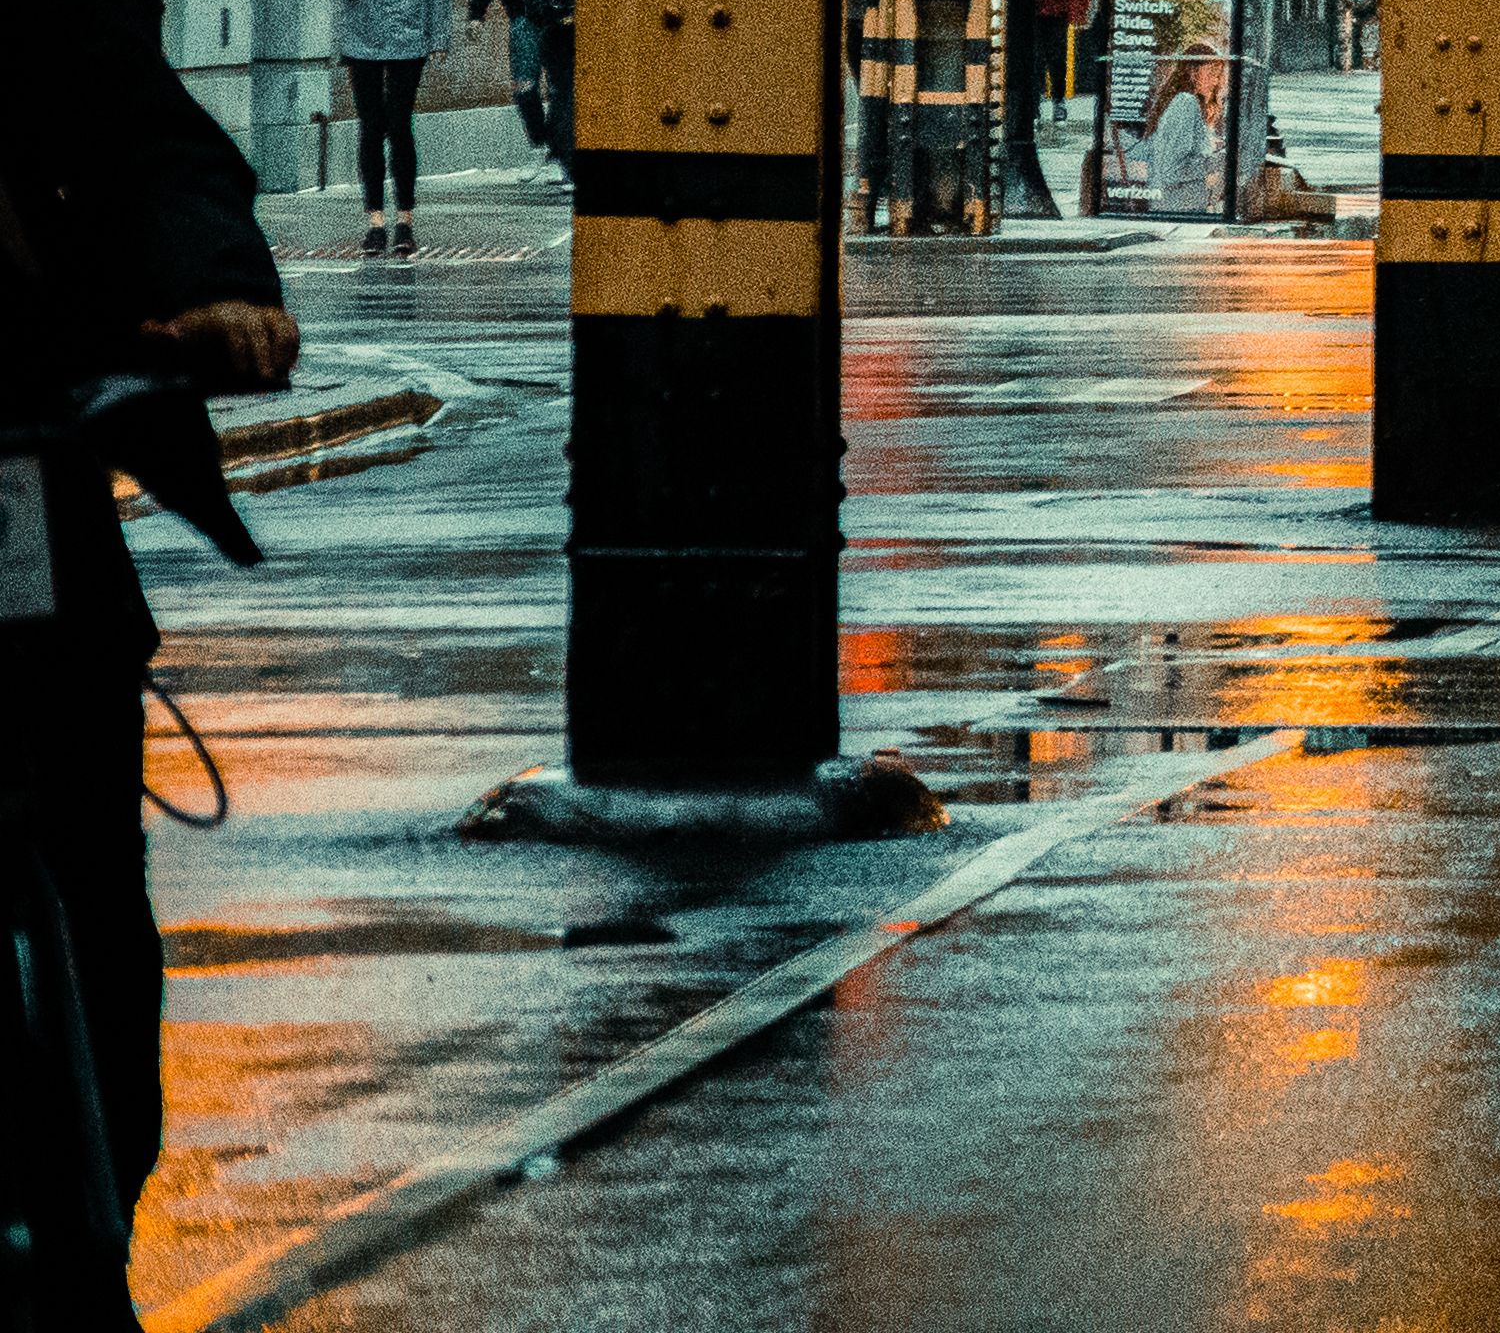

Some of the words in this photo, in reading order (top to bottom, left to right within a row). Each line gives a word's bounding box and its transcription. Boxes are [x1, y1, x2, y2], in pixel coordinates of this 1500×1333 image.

[1113, 14, 1155, 30] Ride.
[1112, 31, 1158, 47] Save.
[1106, 184, 1163, 201] verizon
